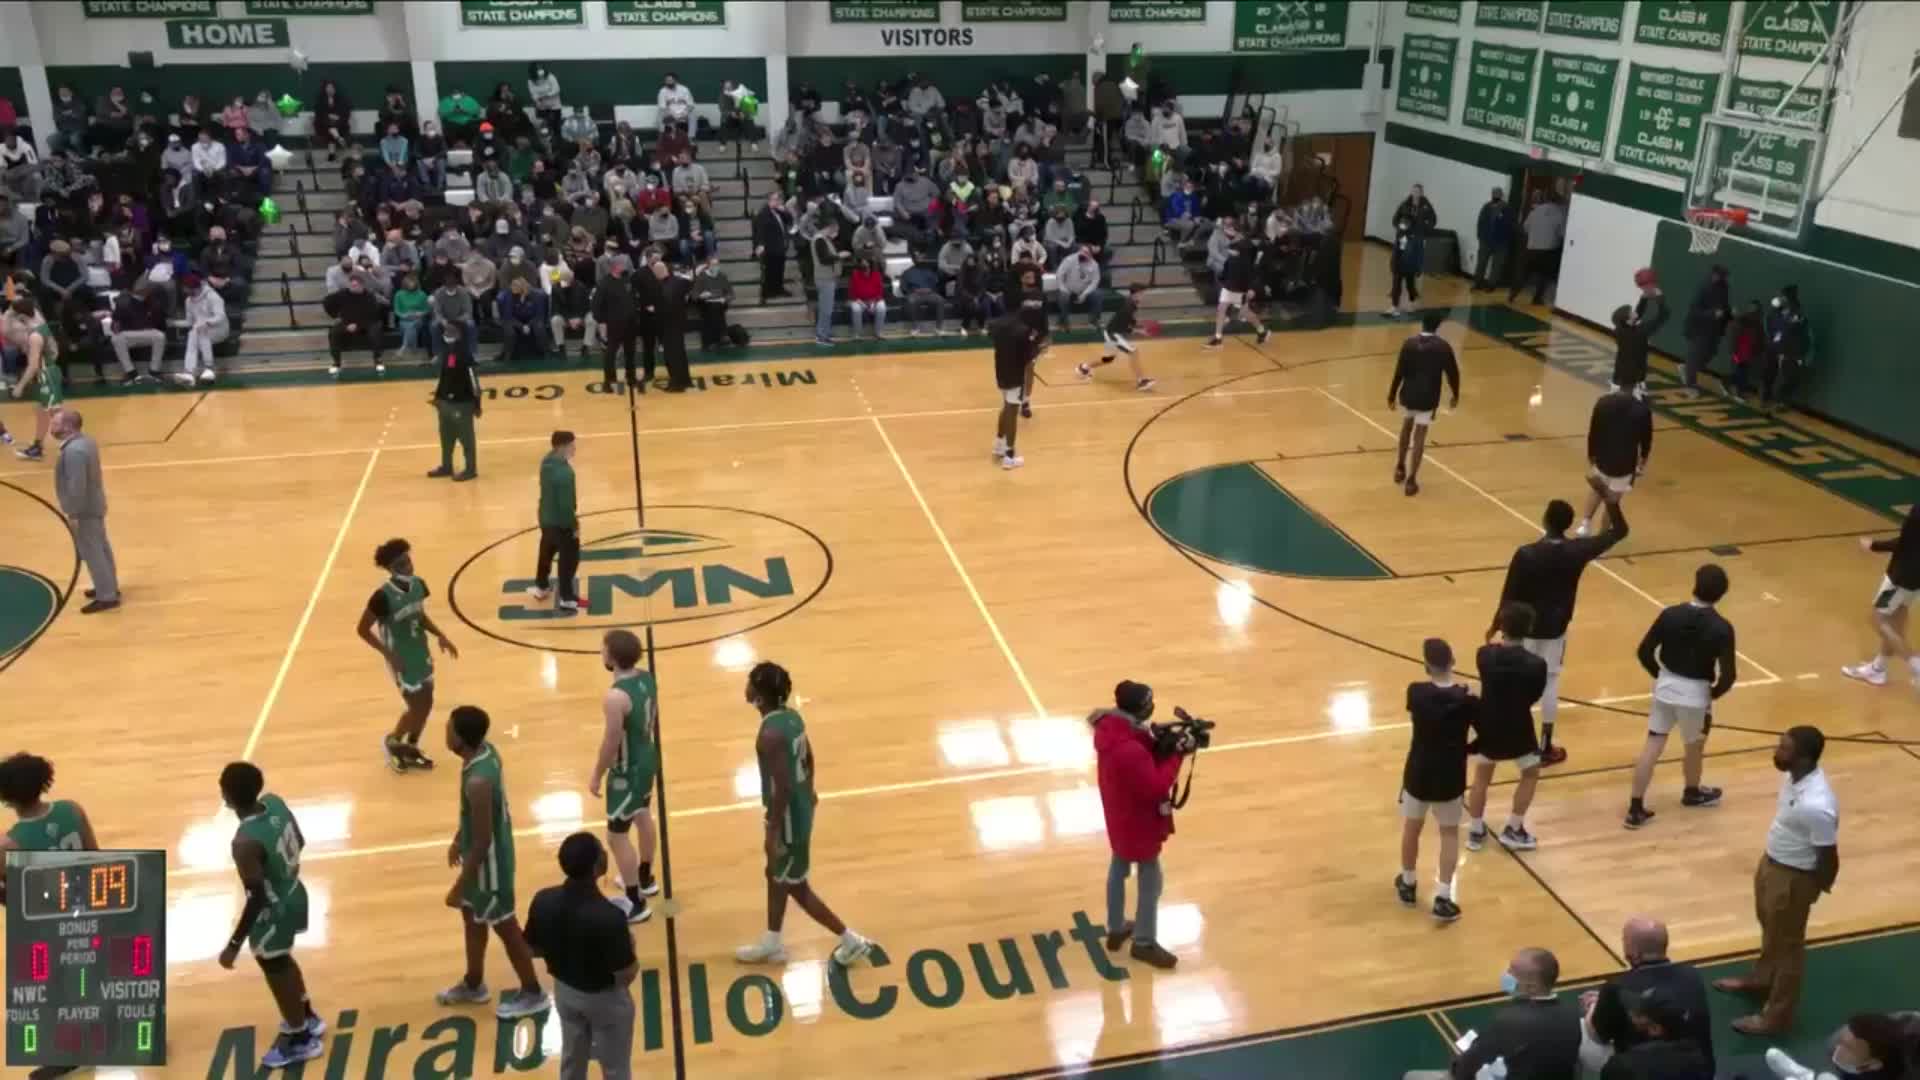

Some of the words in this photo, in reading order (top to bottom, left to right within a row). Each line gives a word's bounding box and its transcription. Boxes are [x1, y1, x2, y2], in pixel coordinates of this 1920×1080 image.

[468, 10, 507, 22] STATE
[510, 9, 577, 21] CHAMPIONS
[613, 12, 649, 23] STATE
[652, 11, 719, 23] CHAMPIONS
[835, 8, 868, 19] STATE
[1658, 9, 1697, 24] CLASS
[1763, 16, 1810, 32] CLASS
[181, 24, 276, 45] HOME
[881, 28, 973, 46] VISITORS
[1638, 132, 1673, 150] CLASS
[498, 556, 795, 620] NWC
[205, 962, 785, 1080] Mirabllo
[828, 909, 1129, 1022] Court
